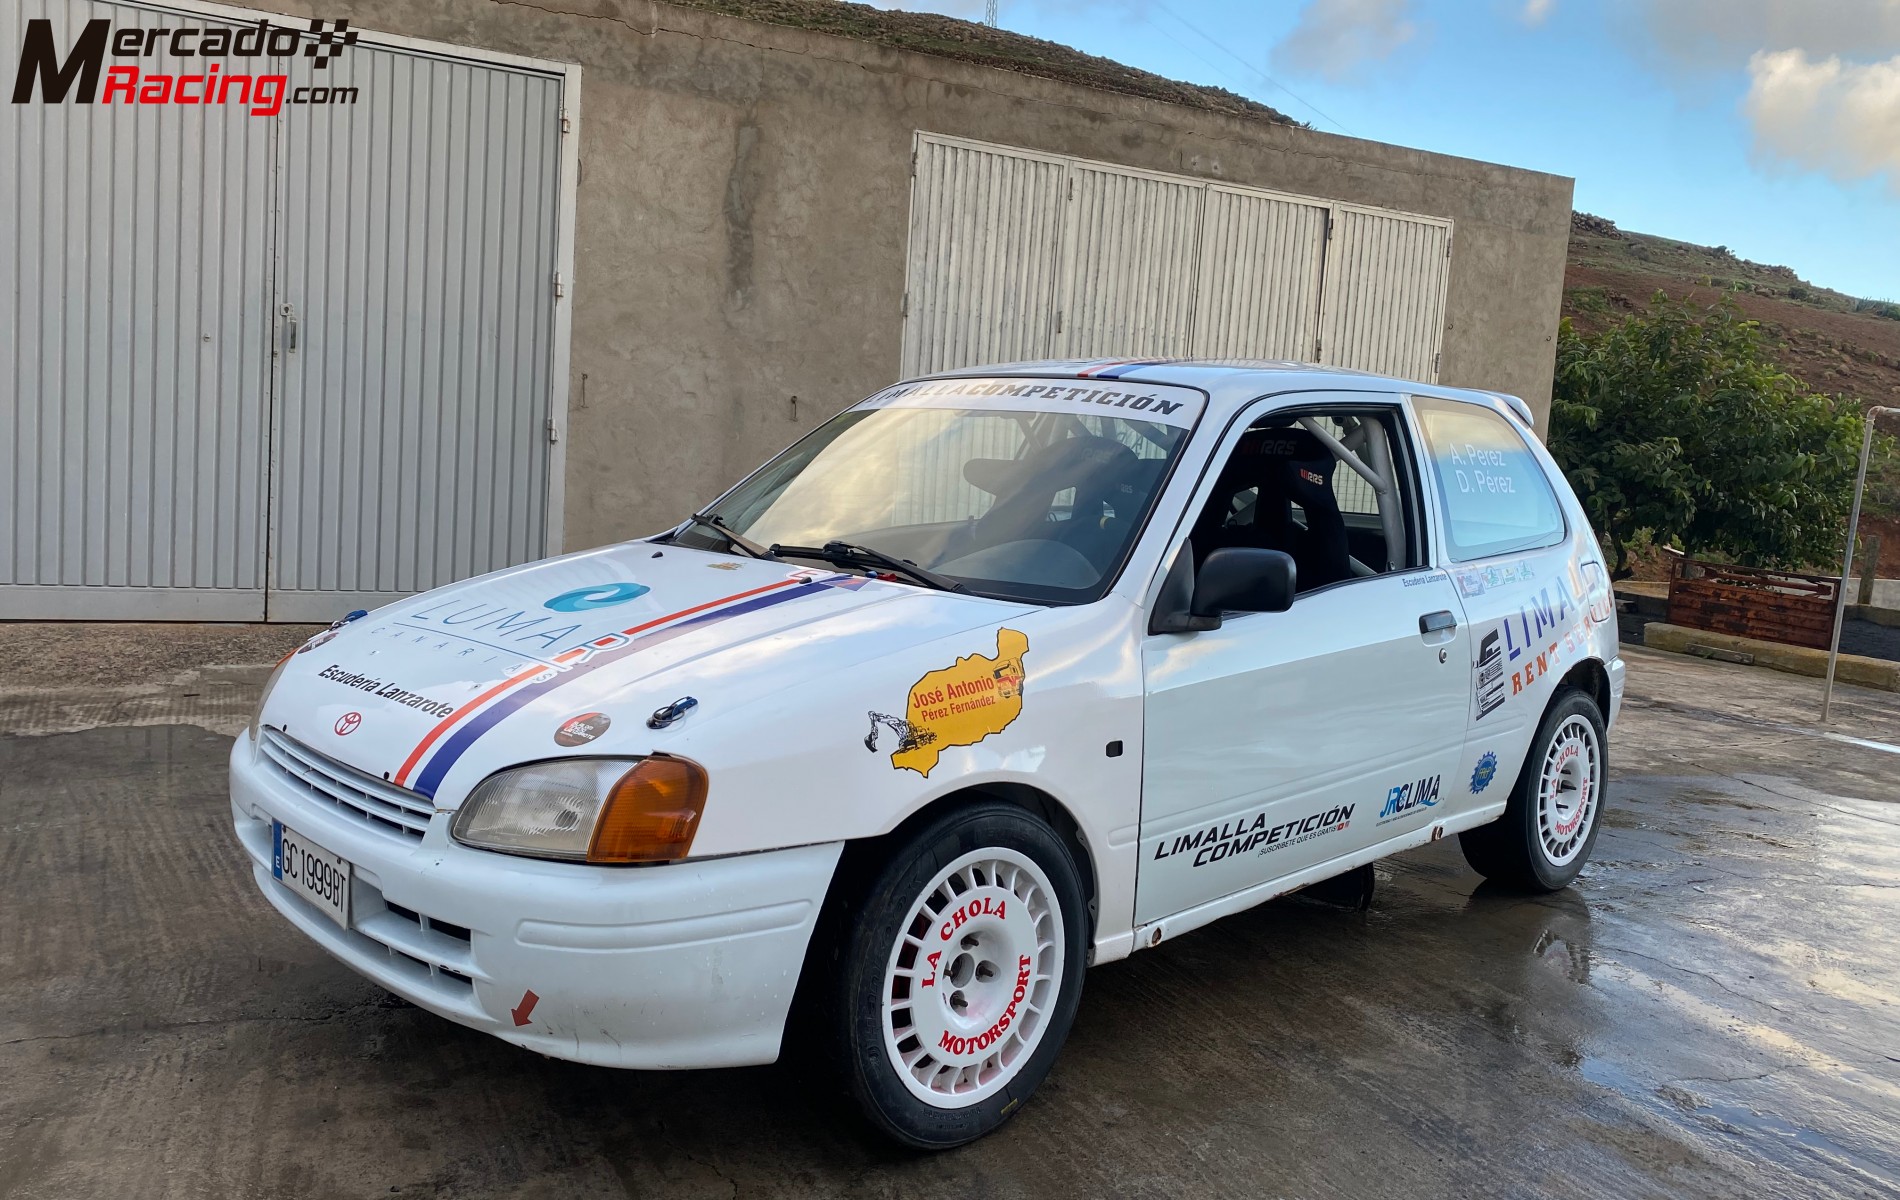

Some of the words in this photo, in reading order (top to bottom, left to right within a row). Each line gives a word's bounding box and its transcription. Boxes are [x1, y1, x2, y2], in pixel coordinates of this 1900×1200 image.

[1449, 442, 1466, 465] A.
[1455, 469, 1475, 493] D.
[1473, 469, 1516, 494] Pérez
[371, 626, 554, 683] CANARIAS
[411, 599, 630, 662] LUMAR
[318, 664, 382, 692] Escudería
[374, 682, 454, 719] Lanzarote
[912, 686, 944, 709] José
[946, 676, 995, 700] Antonio
[1511, 641, 1561, 696] RENT
[921, 706, 949, 722] Pérez
[949, 695, 996, 715] Fernández
[1550, 777, 1557, 801] LA
[1555, 744, 1580, 773] CHOLA
[1554, 776, 1588, 837] MOTORSPORT
[1154, 812, 1266, 861] LIMALLA
[1193, 803, 1356, 868] COMPETICIÓN
[921, 950, 942, 989] LA
[940, 897, 1006, 942] CHOLA
[938, 954, 1032, 1056] MOTORSPORT
